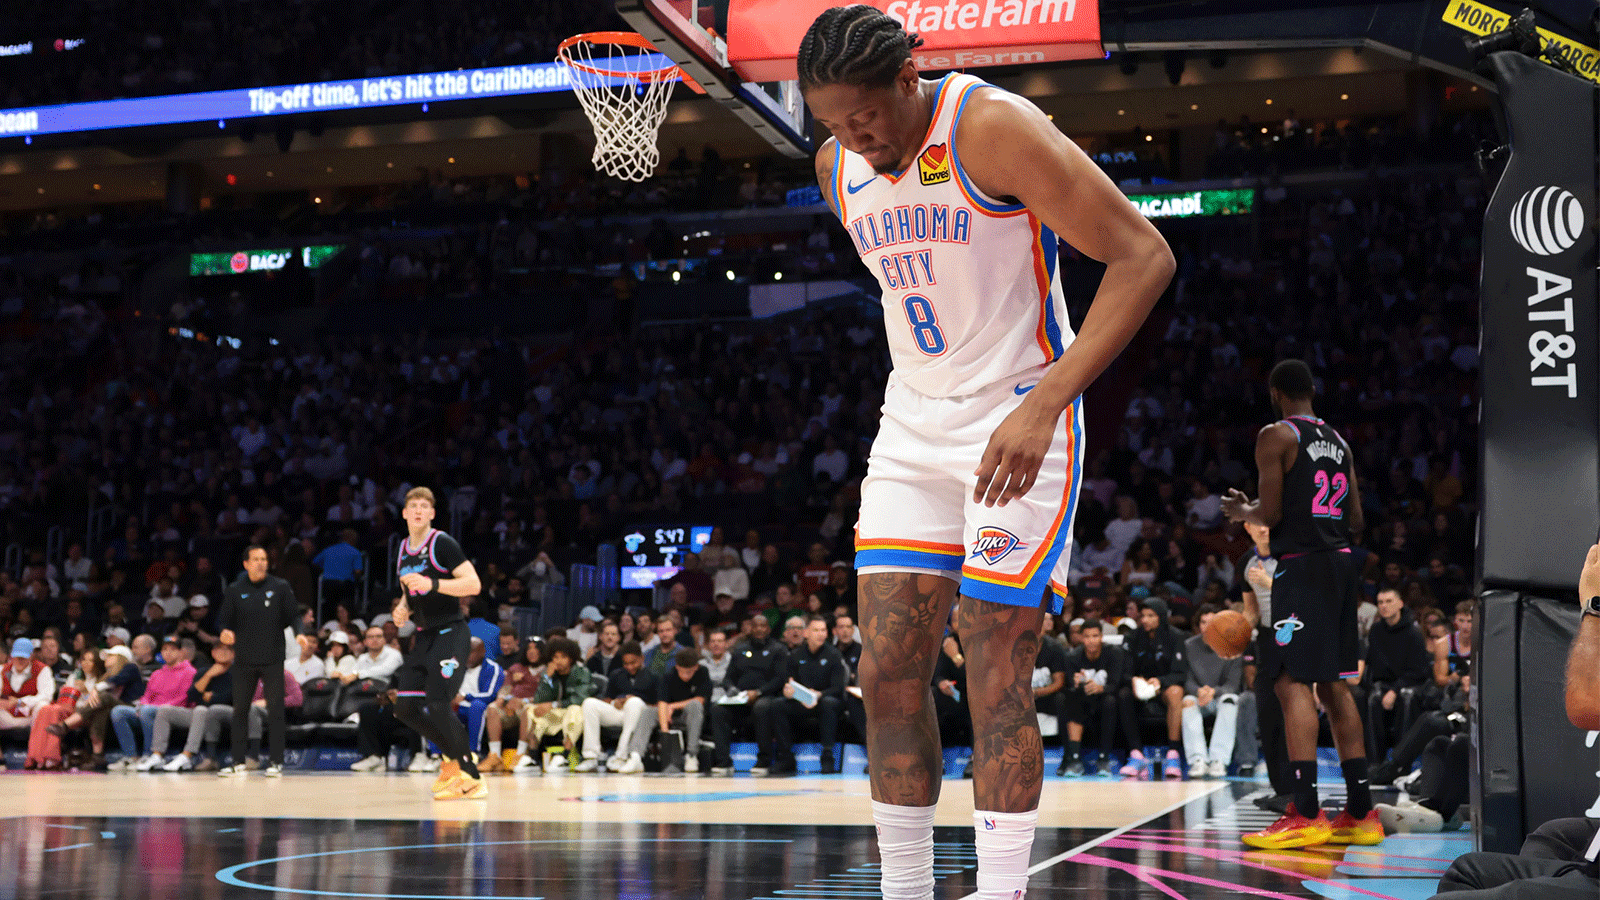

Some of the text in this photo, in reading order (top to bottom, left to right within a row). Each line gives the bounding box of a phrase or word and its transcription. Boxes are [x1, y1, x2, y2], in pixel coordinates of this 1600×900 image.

[887, 0, 1076, 33] State Farm
[1454, 2, 1505, 34] MORG
[955, 51, 1045, 66] Farm
[249, 66, 569, 114] Tip-off time, let's hit the Caribbean
[848, 203, 973, 256] KLAHOMA
[879, 248, 937, 290] CITY
[902, 292, 948, 357] 8
[1526, 266, 1577, 398] AT&T
[1306, 440, 1345, 465] WIGGINS
[1311, 470, 1349, 520] 22
[974, 536, 1008, 554] OKC
